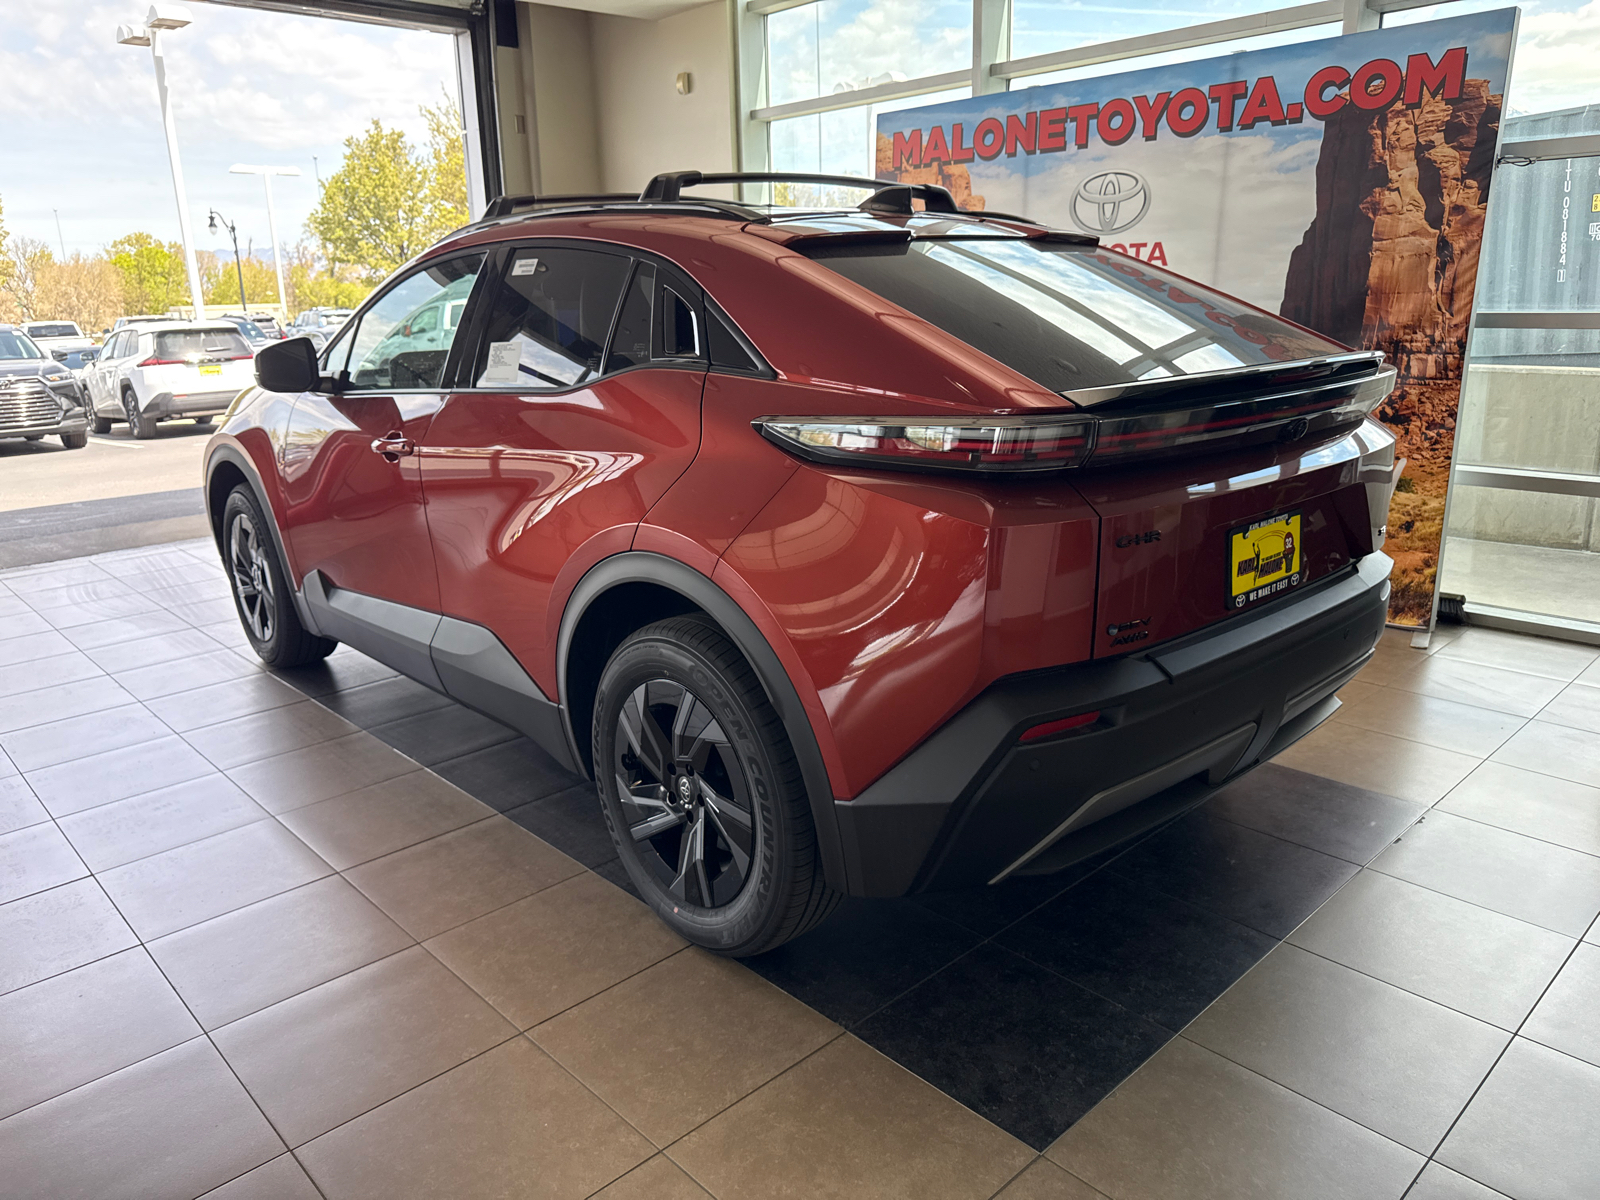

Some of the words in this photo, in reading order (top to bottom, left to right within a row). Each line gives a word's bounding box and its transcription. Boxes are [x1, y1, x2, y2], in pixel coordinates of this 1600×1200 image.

[892, 46, 1469, 171] MALONETOYOTA.COM
[1237, 556, 1256, 577] KARL
[1285, 537, 1293, 548] 32
[1249, 590, 1258, 602] WE
[1257, 585, 1271, 599] MAKE
[1271, 583, 1277, 593] IT
[1277, 578, 1289, 591] EASY
[592, 691, 606, 768] TIRES
[691, 665, 747, 739] OPEN
[746, 751, 775, 907] COUNTRY
